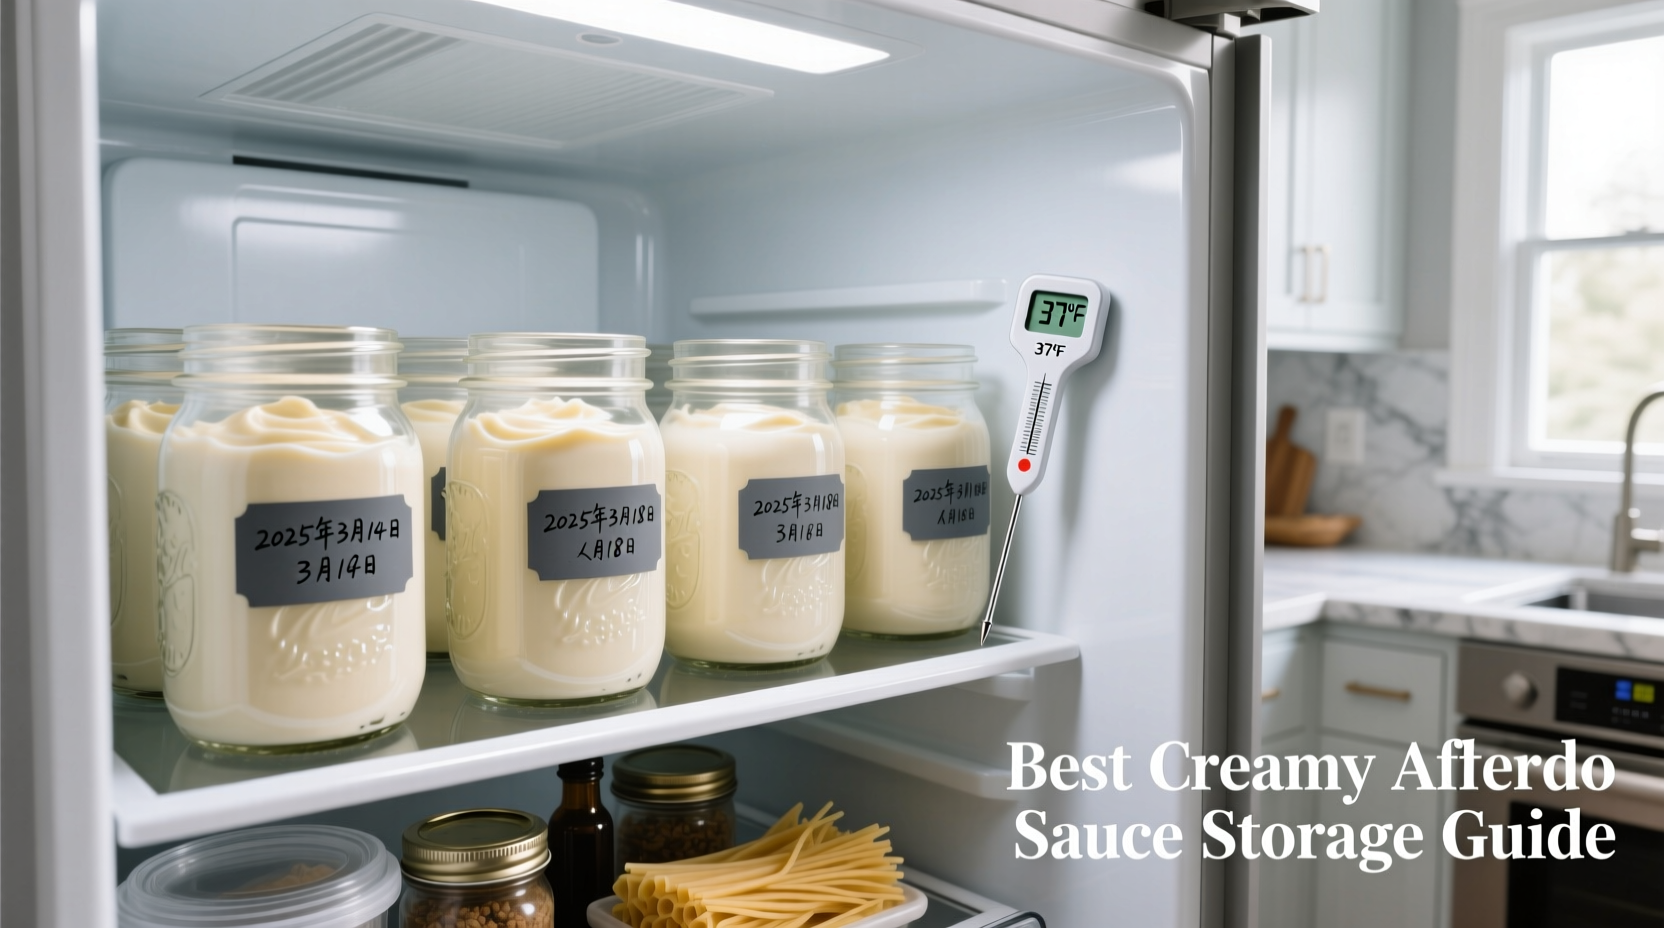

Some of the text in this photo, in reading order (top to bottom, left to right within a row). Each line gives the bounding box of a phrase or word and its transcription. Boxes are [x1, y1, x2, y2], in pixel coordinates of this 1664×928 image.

[254, 516, 400, 551] 2025年3月14日
[543, 503, 654, 534] 2025年3月18日
